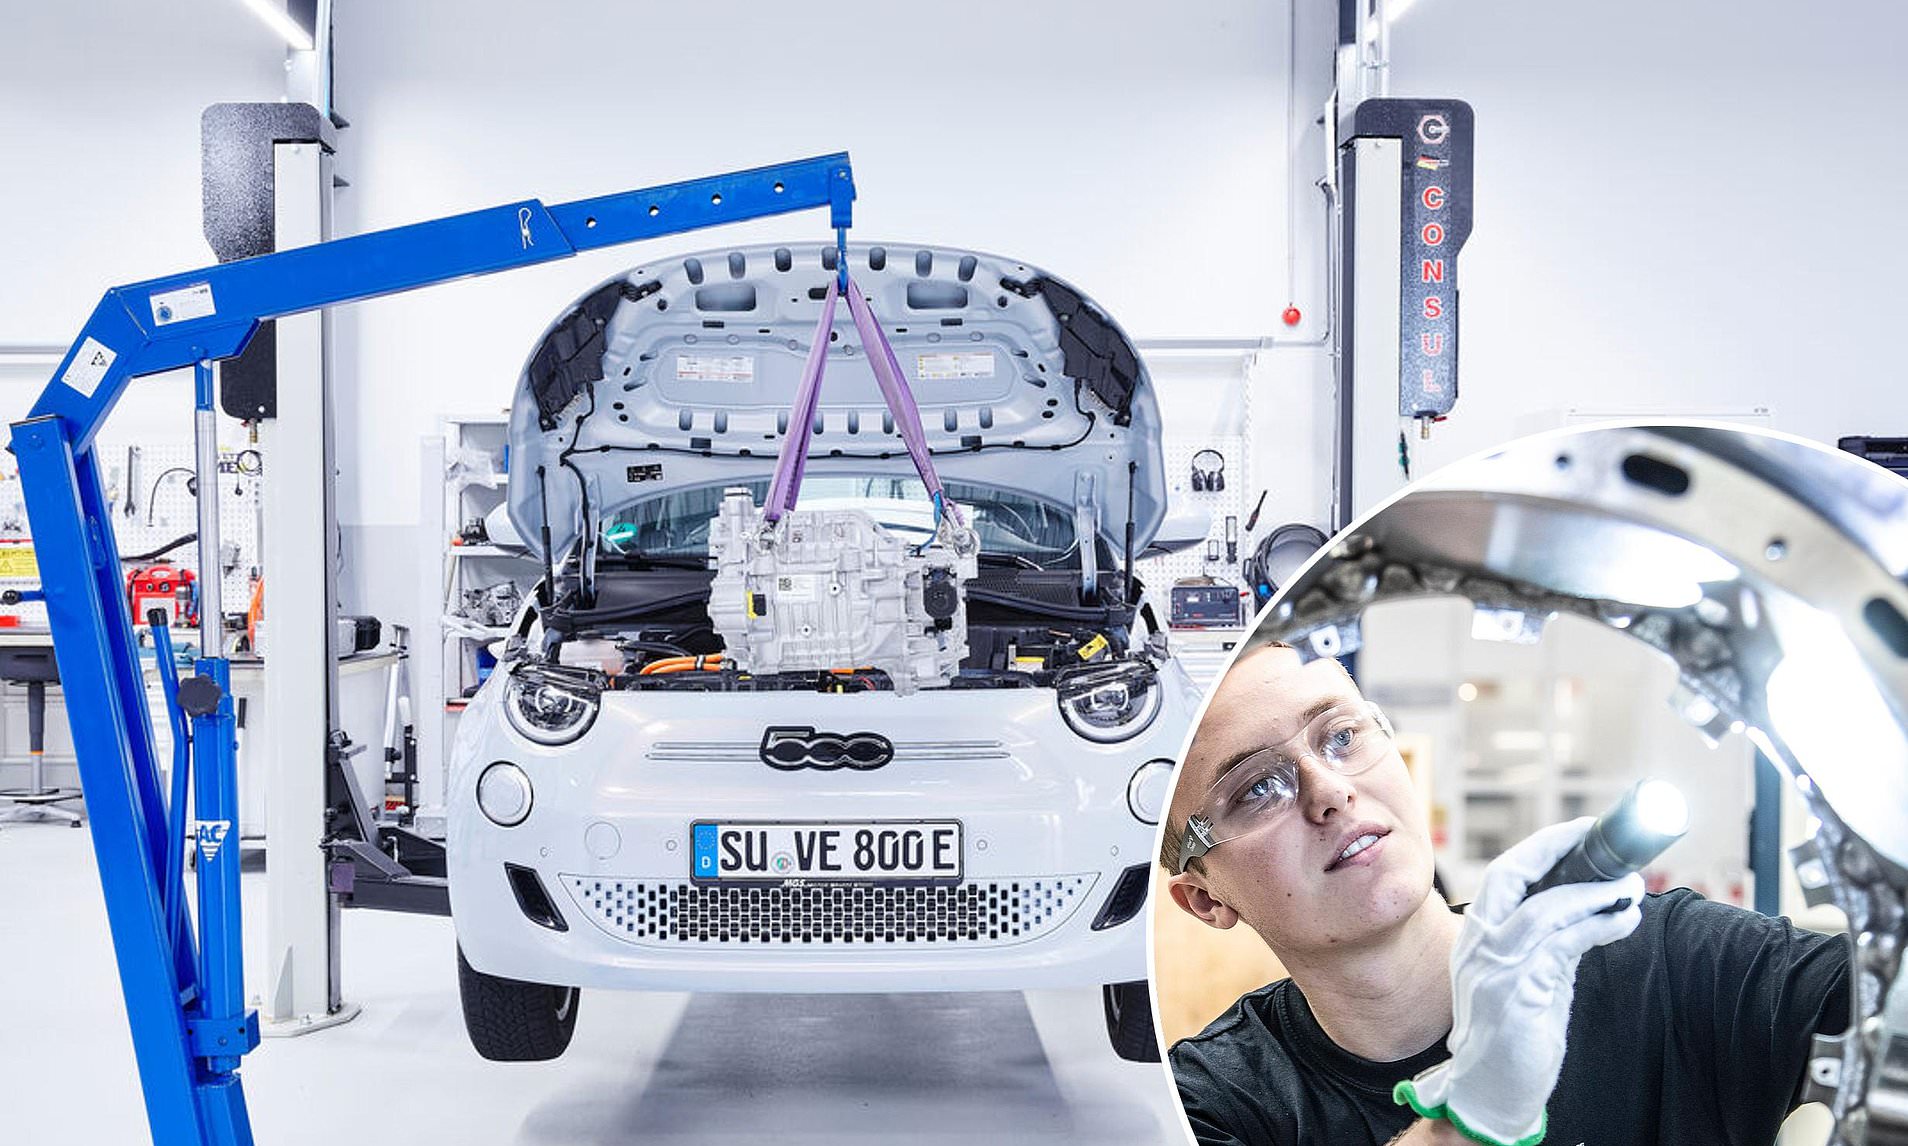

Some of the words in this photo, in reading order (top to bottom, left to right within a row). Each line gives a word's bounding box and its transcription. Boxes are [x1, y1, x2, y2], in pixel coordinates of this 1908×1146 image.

[1421, 187, 1444, 393] CONSUL
[759, 726, 894, 770] 500
[701, 855, 711, 868] D
[720, 830, 767, 871] SU
[794, 830, 842, 871] VE
[854, 829, 924, 871] 800
[933, 829, 955, 870] E
